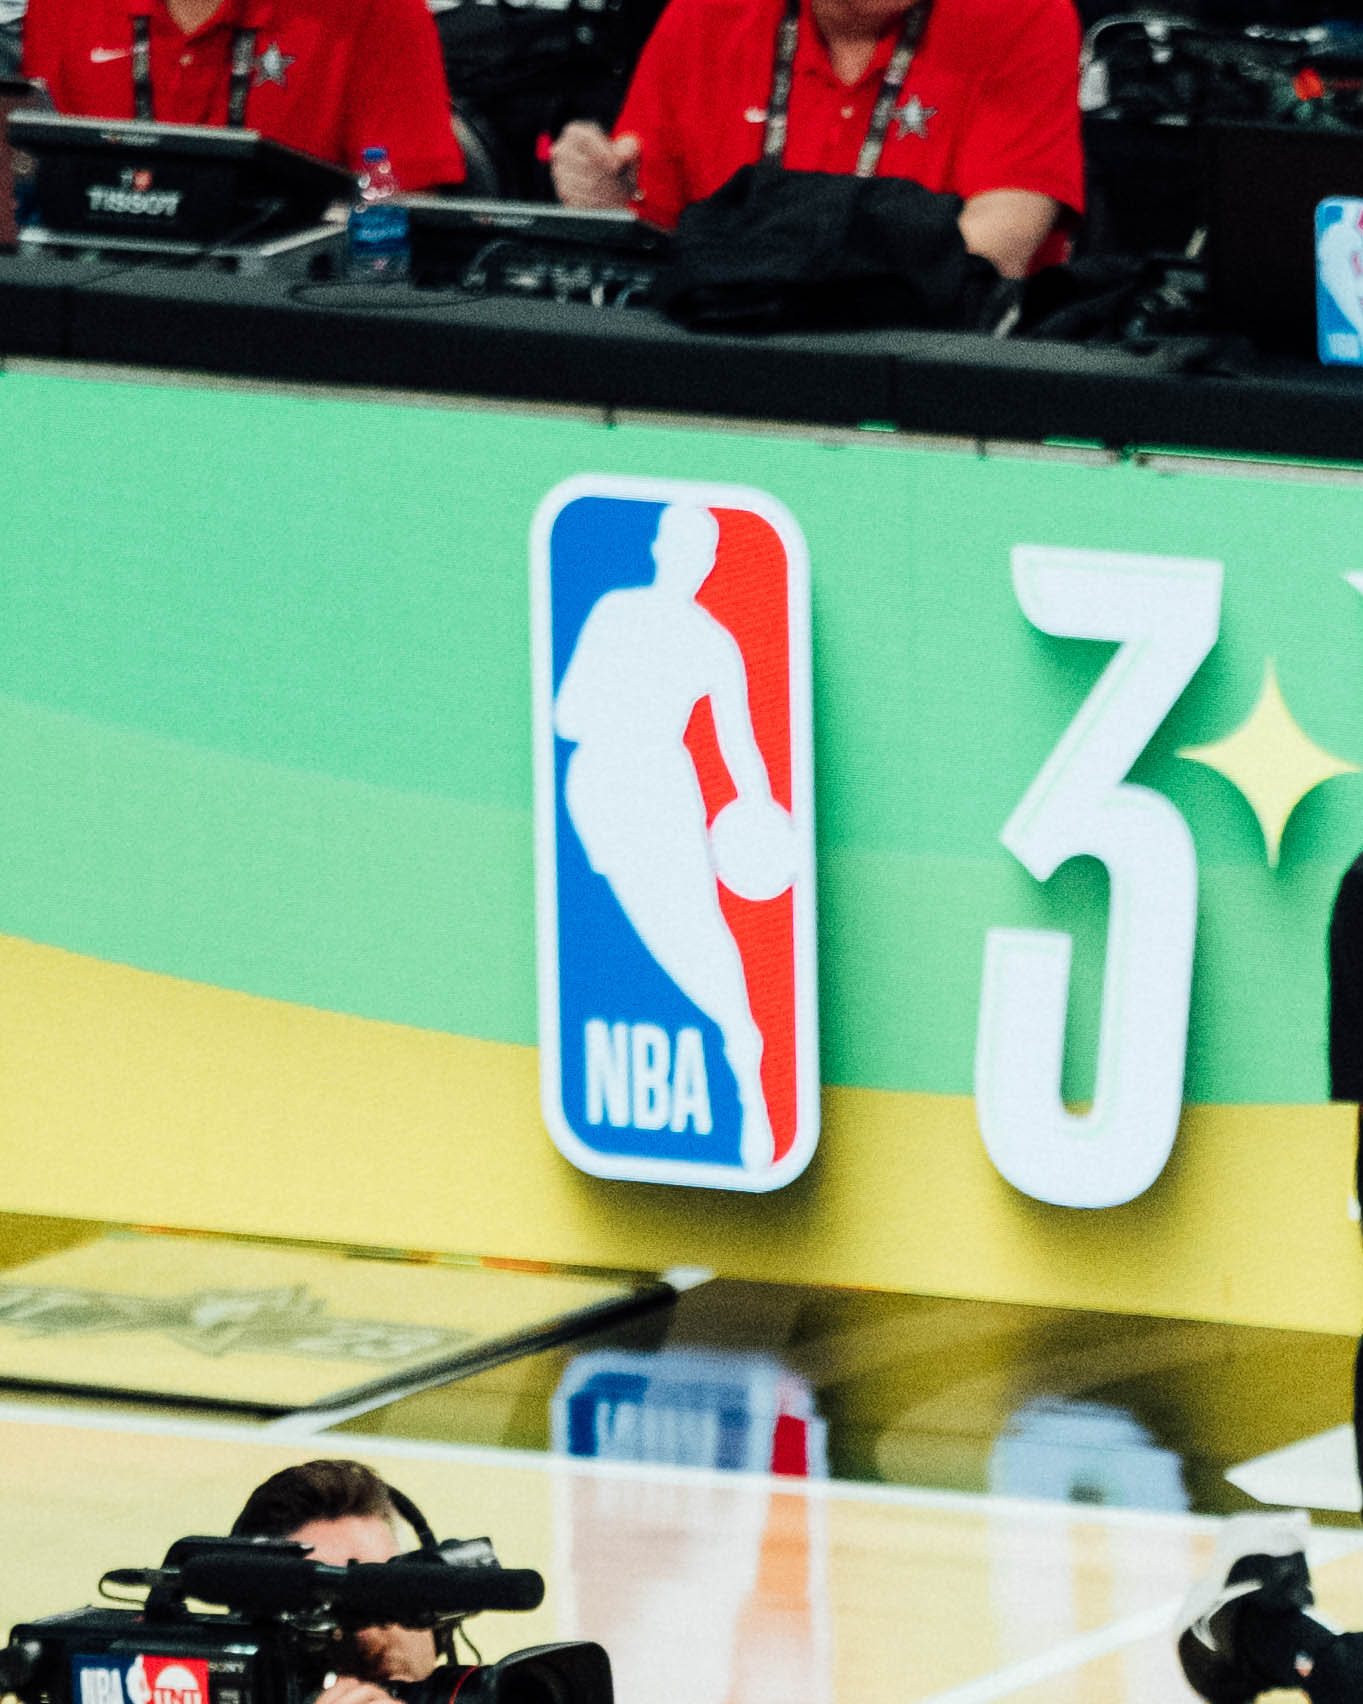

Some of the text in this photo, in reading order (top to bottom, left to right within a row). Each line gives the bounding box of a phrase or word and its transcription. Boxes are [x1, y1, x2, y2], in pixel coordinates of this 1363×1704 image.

[86, 186, 182, 216] TISSOT
[974, 542, 1225, 1209] 3
[583, 1019, 713, 1136] NBA
